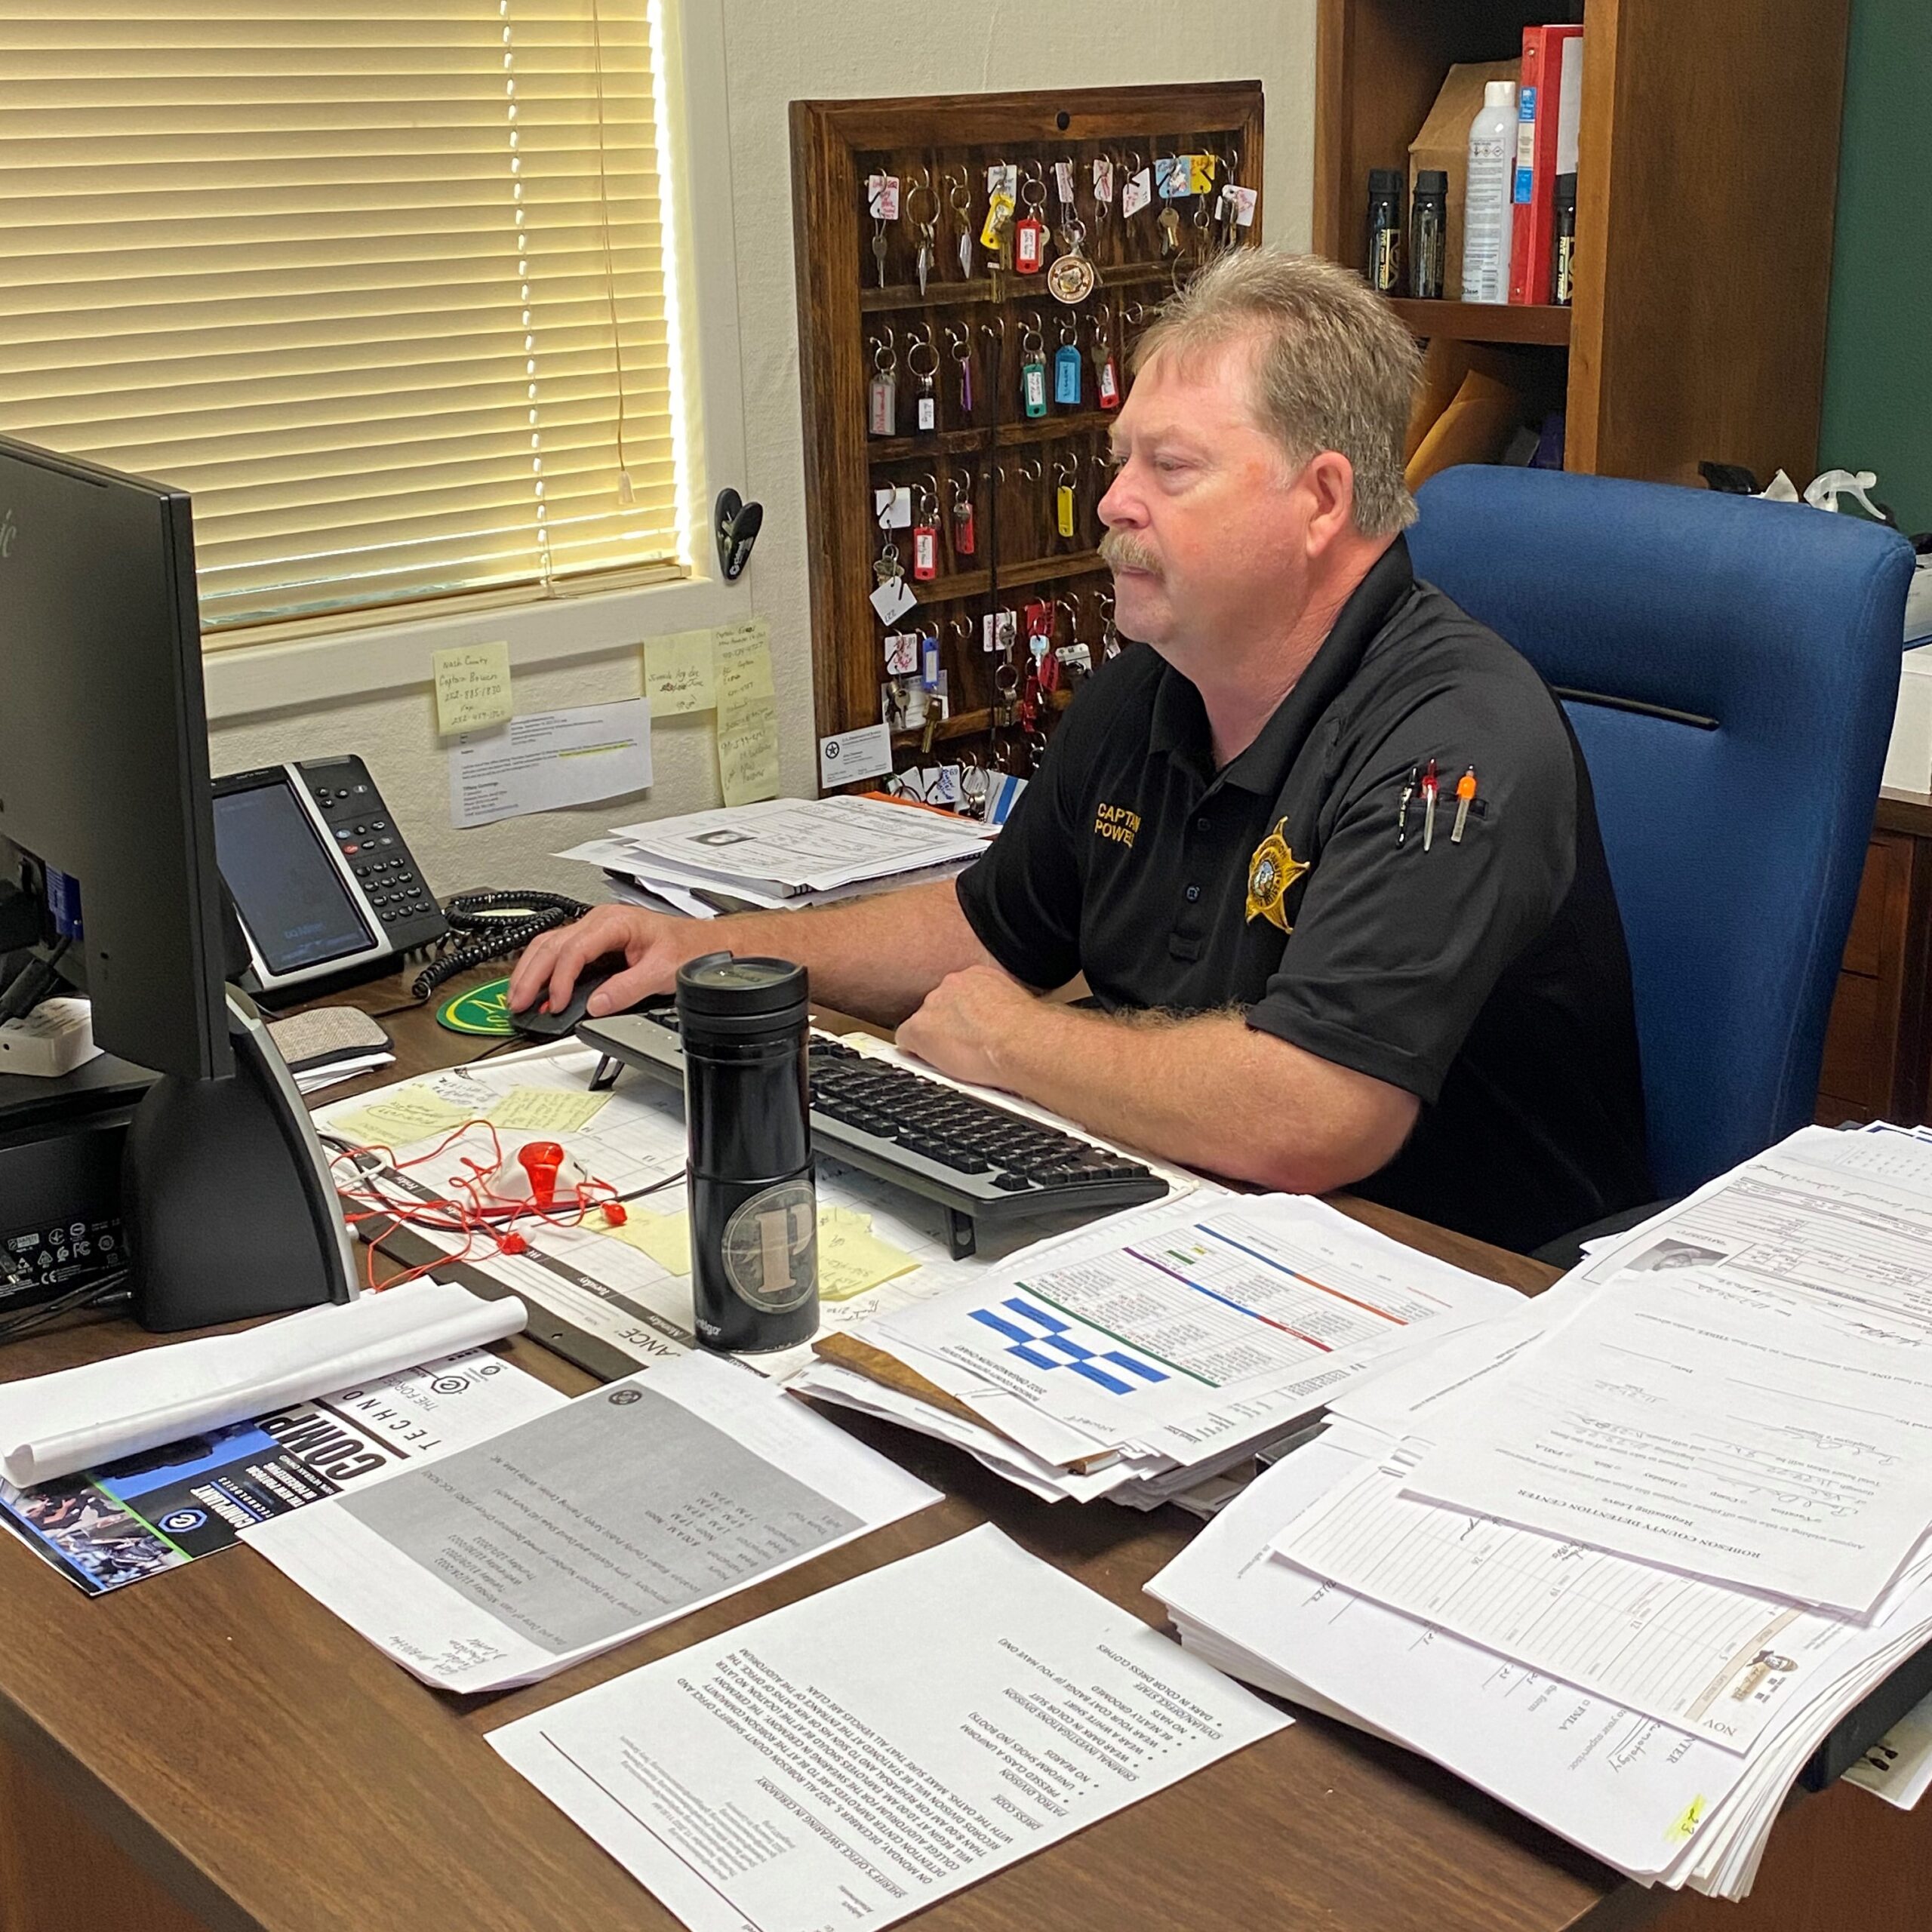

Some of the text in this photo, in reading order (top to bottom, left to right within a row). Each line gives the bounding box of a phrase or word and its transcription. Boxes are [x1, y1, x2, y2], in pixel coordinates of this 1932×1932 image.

[882, 608, 897, 622] 227
[578, 1274, 611, 1298] Tuesday
[649, 1315, 684, 1337] Monday
[411, 1395, 441, 1411] THE
[244, 1465, 282, 1490] PROTOCOL
[216, 1476, 275, 1518] TECHNOLOGIES
[272, 1485, 296, 1499] NEW
[1515, 1489, 1568, 1506] CENTER
[188, 1482, 257, 1529] COMPLIANT
[1567, 1503, 1642, 1527] DETENTION
[1599, 1497, 1696, 1526] Requesting Leave
[1641, 1523, 1699, 1542] COUNTY
[1548, 1586, 1561, 1598] 19
[1629, 1619, 1641, 1631] 12
[995, 1638, 1022, 1653] ONE)
[1016, 1651, 1041, 1666] HAVE
[1035, 1664, 1057, 1678] YOU
[673, 1677, 697, 1692] AND
[1061, 1682, 1093, 1702] BADGE
[1095, 1644, 1214, 1721] DARK IN COLOR DRESS CLOTHES
[689, 1690, 718, 1709] OFFICE
[1027, 1692, 1051, 1706] SUIT
[1061, 1699, 1090, 1716] SHIRT
[1086, 1700, 1114, 1716] COAT
[1527, 1693, 1547, 1714] form
[1044, 1704, 1076, 1724] COLOR
[1088, 1684, 1174, 1740] BE NEATLY GROOMED
[1131, 1681, 1223, 1740] CIVILIAN/OFFICE STAFF
[1558, 1703, 1585, 1734] FMLA
[1084, 1714, 1115, 1734] WHITE
[1108, 1715, 1136, 1731] YOUR
[1148, 1709, 1189, 1734] NO HATS
[1601, 1715, 1618, 1734] your
[1702, 1716, 1737, 1737] NOV
[741, 1732, 775, 1756] COUNTY
[958, 1724, 1000, 1751] UNIFORM
[1000, 1687, 1140, 1782] CRIMINAL INVESTIGATIONS DIVISION
[1080, 1728, 1107, 1746] DARK
[1131, 1729, 1161, 1748] WEAR
[965, 1711, 1078, 1790] UNIFORM SHOES (NO BOOTS)
[1102, 1743, 1131, 1761] WEAR
[1116, 1737, 1146, 1755] WEAR
[1567, 1730, 1604, 1774] supervisor.
[768, 1754, 808, 1783] ROBESON
[1000, 1755, 1029, 1774] CLASS
[1041, 1749, 1092, 1783] NO BEARDS
[801, 1780, 820, 1792] ALL
[997, 1768, 1067, 1817] PATROL DIVISION
[1022, 1770, 1063, 1797] PRESSED
[813, 1790, 837, 1806] 2022
[990, 1794, 1041, 1830] DRESS CODE
[804, 1767, 948, 1878] DETENTION CENTER EMPLOYEES ARE TO
[837, 1810, 884, 1845] DECEMBER
[752, 1776, 906, 1899] SHERIFF'S OFFICE SWEARING IN CEREMONY
[877, 1841, 922, 1875] MONDAY,
[915, 1872, 934, 1884] ON
